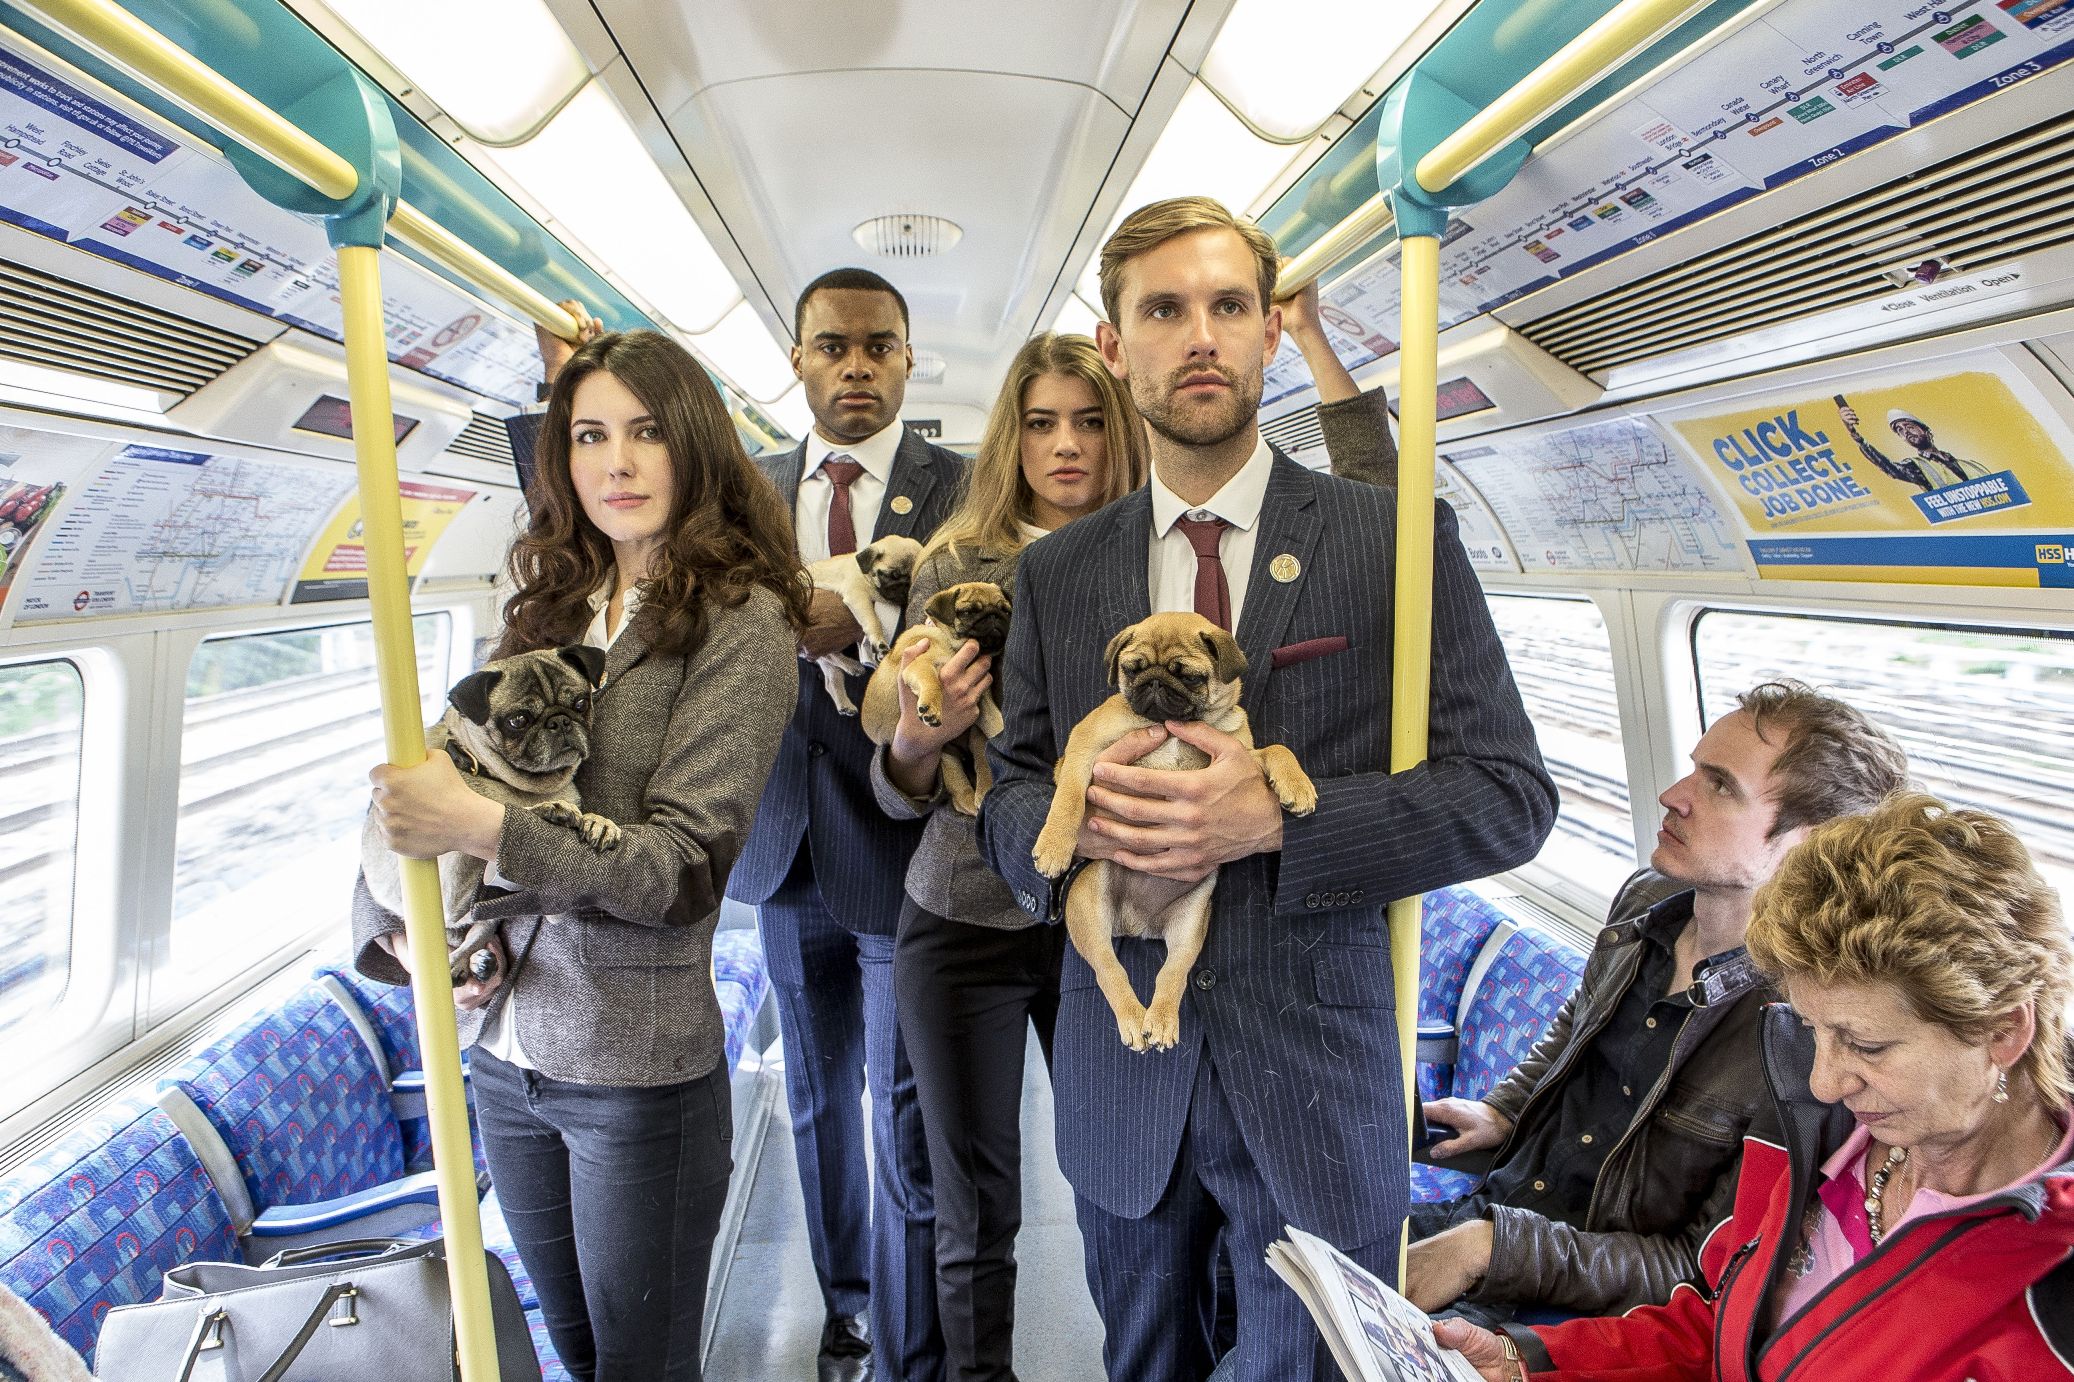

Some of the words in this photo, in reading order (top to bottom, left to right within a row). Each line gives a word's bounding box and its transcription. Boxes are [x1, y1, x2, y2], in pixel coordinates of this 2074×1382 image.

[1904, 5, 1931, 20] West
[1846, 21, 1882, 41] Canning
[1859, 31, 1884, 45] Town
[1971, 40, 1987, 52] DLR
[1801, 50, 1827, 66] North
[1803, 53, 1844, 76] Greenwich
[1760, 74, 1785, 89] Canary
[1988, 66, 2031, 88] Zone
[2024, 60, 2042, 72] 3
[29, 77, 50, 90] works
[48, 86, 57, 94] to
[1768, 80, 1791, 95] Wharf
[1721, 96, 1745, 111] Canada
[1730, 103, 1751, 116] Water
[5, 124, 47, 146] Hampstead
[25, 122, 45, 136] West
[57, 149, 77, 160] Road
[61, 140, 88, 157] Finchley
[1808, 152, 1835, 169] Zone
[1831, 148, 1846, 157] 2
[1888, 300, 1917, 311] Close
[1919, 282, 1977, 303] Ventilation
[1981, 273, 2013, 287] Open
[1713, 409, 1831, 472] CLICK.
[1738, 448, 1852, 496] COLLECT.
[1760, 492, 1801, 518] JOB
[1795, 475, 1872, 509] DONE.
[1923, 493, 1949, 509] FEEL
[1944, 477, 2009, 503] UNSTOPPABLE
[1937, 506, 1957, 518] WITH
[1953, 502, 1968, 514] THE
[1966, 499, 1983, 512] NEW
[1980, 491, 2012, 508] HSS.COM
[2037, 547, 2062, 560] HSS
